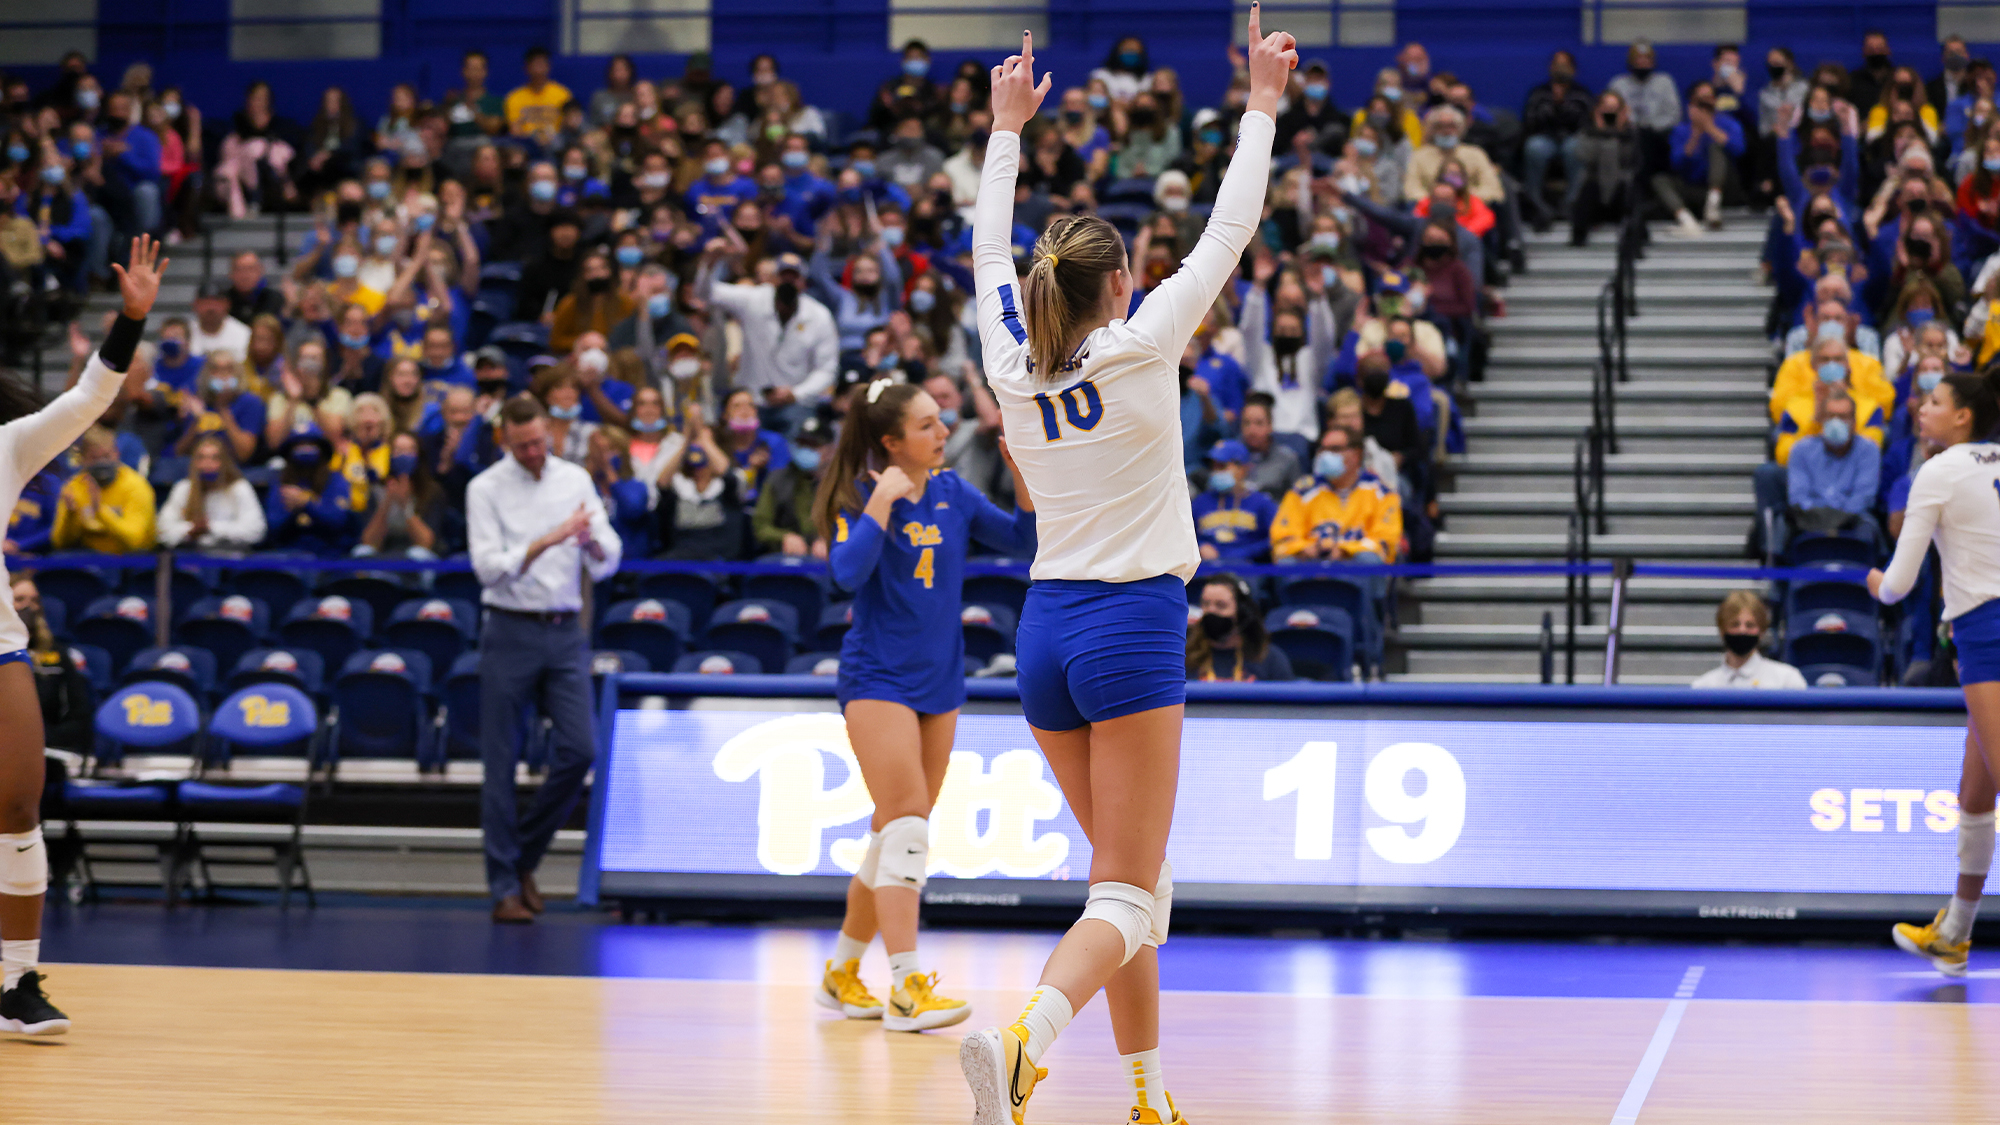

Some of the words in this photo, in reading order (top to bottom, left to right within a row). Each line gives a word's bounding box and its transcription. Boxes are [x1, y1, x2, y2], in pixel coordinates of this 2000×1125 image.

[1032, 379, 1106, 443] 10
[913, 547, 935, 589] 4
[712, 712, 1070, 879] Ptt
[1262, 741, 1467, 864] 19
[1809, 788, 1961, 833] SETS
